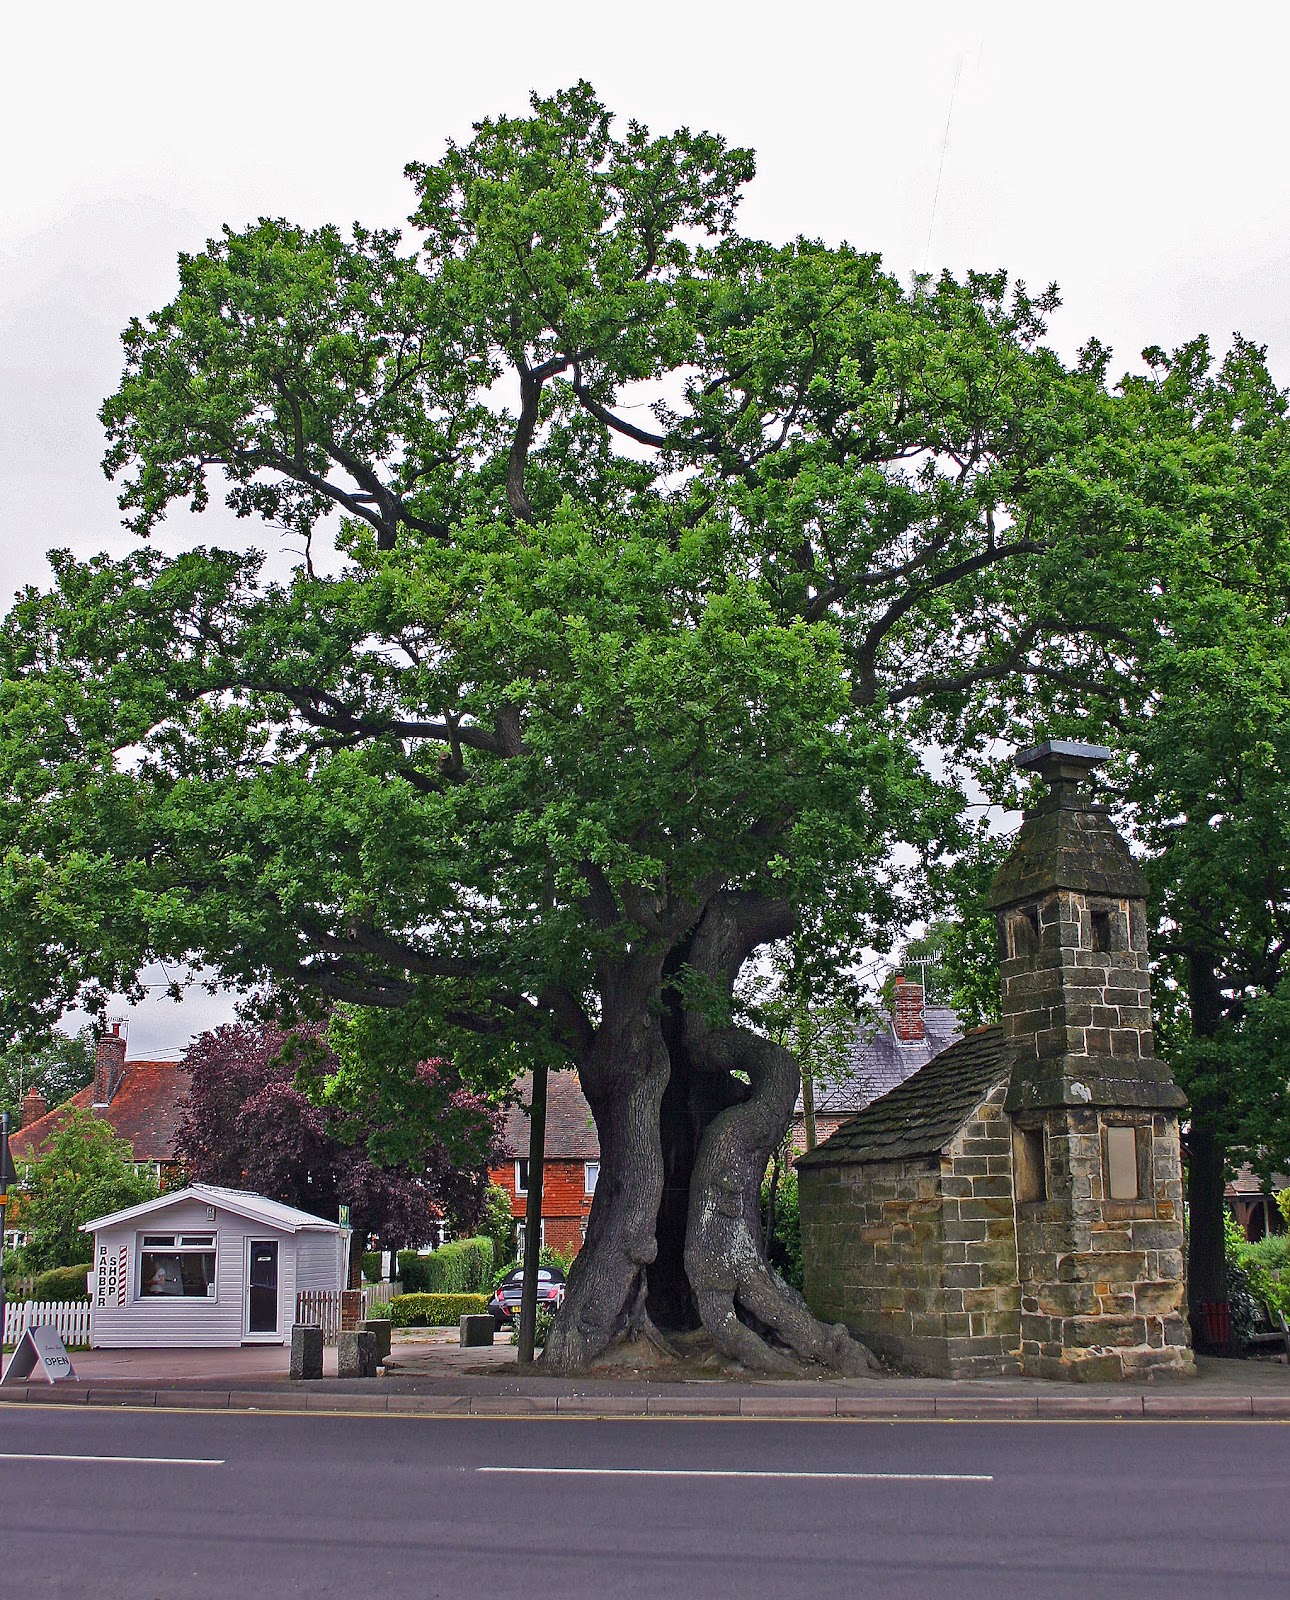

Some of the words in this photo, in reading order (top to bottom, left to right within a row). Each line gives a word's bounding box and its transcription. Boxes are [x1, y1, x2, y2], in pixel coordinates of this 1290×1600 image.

[98, 1246, 107, 1307] BARBER
[108, 1256, 117, 1296] SHOP
[45, 1356, 69, 1366] OPEN
